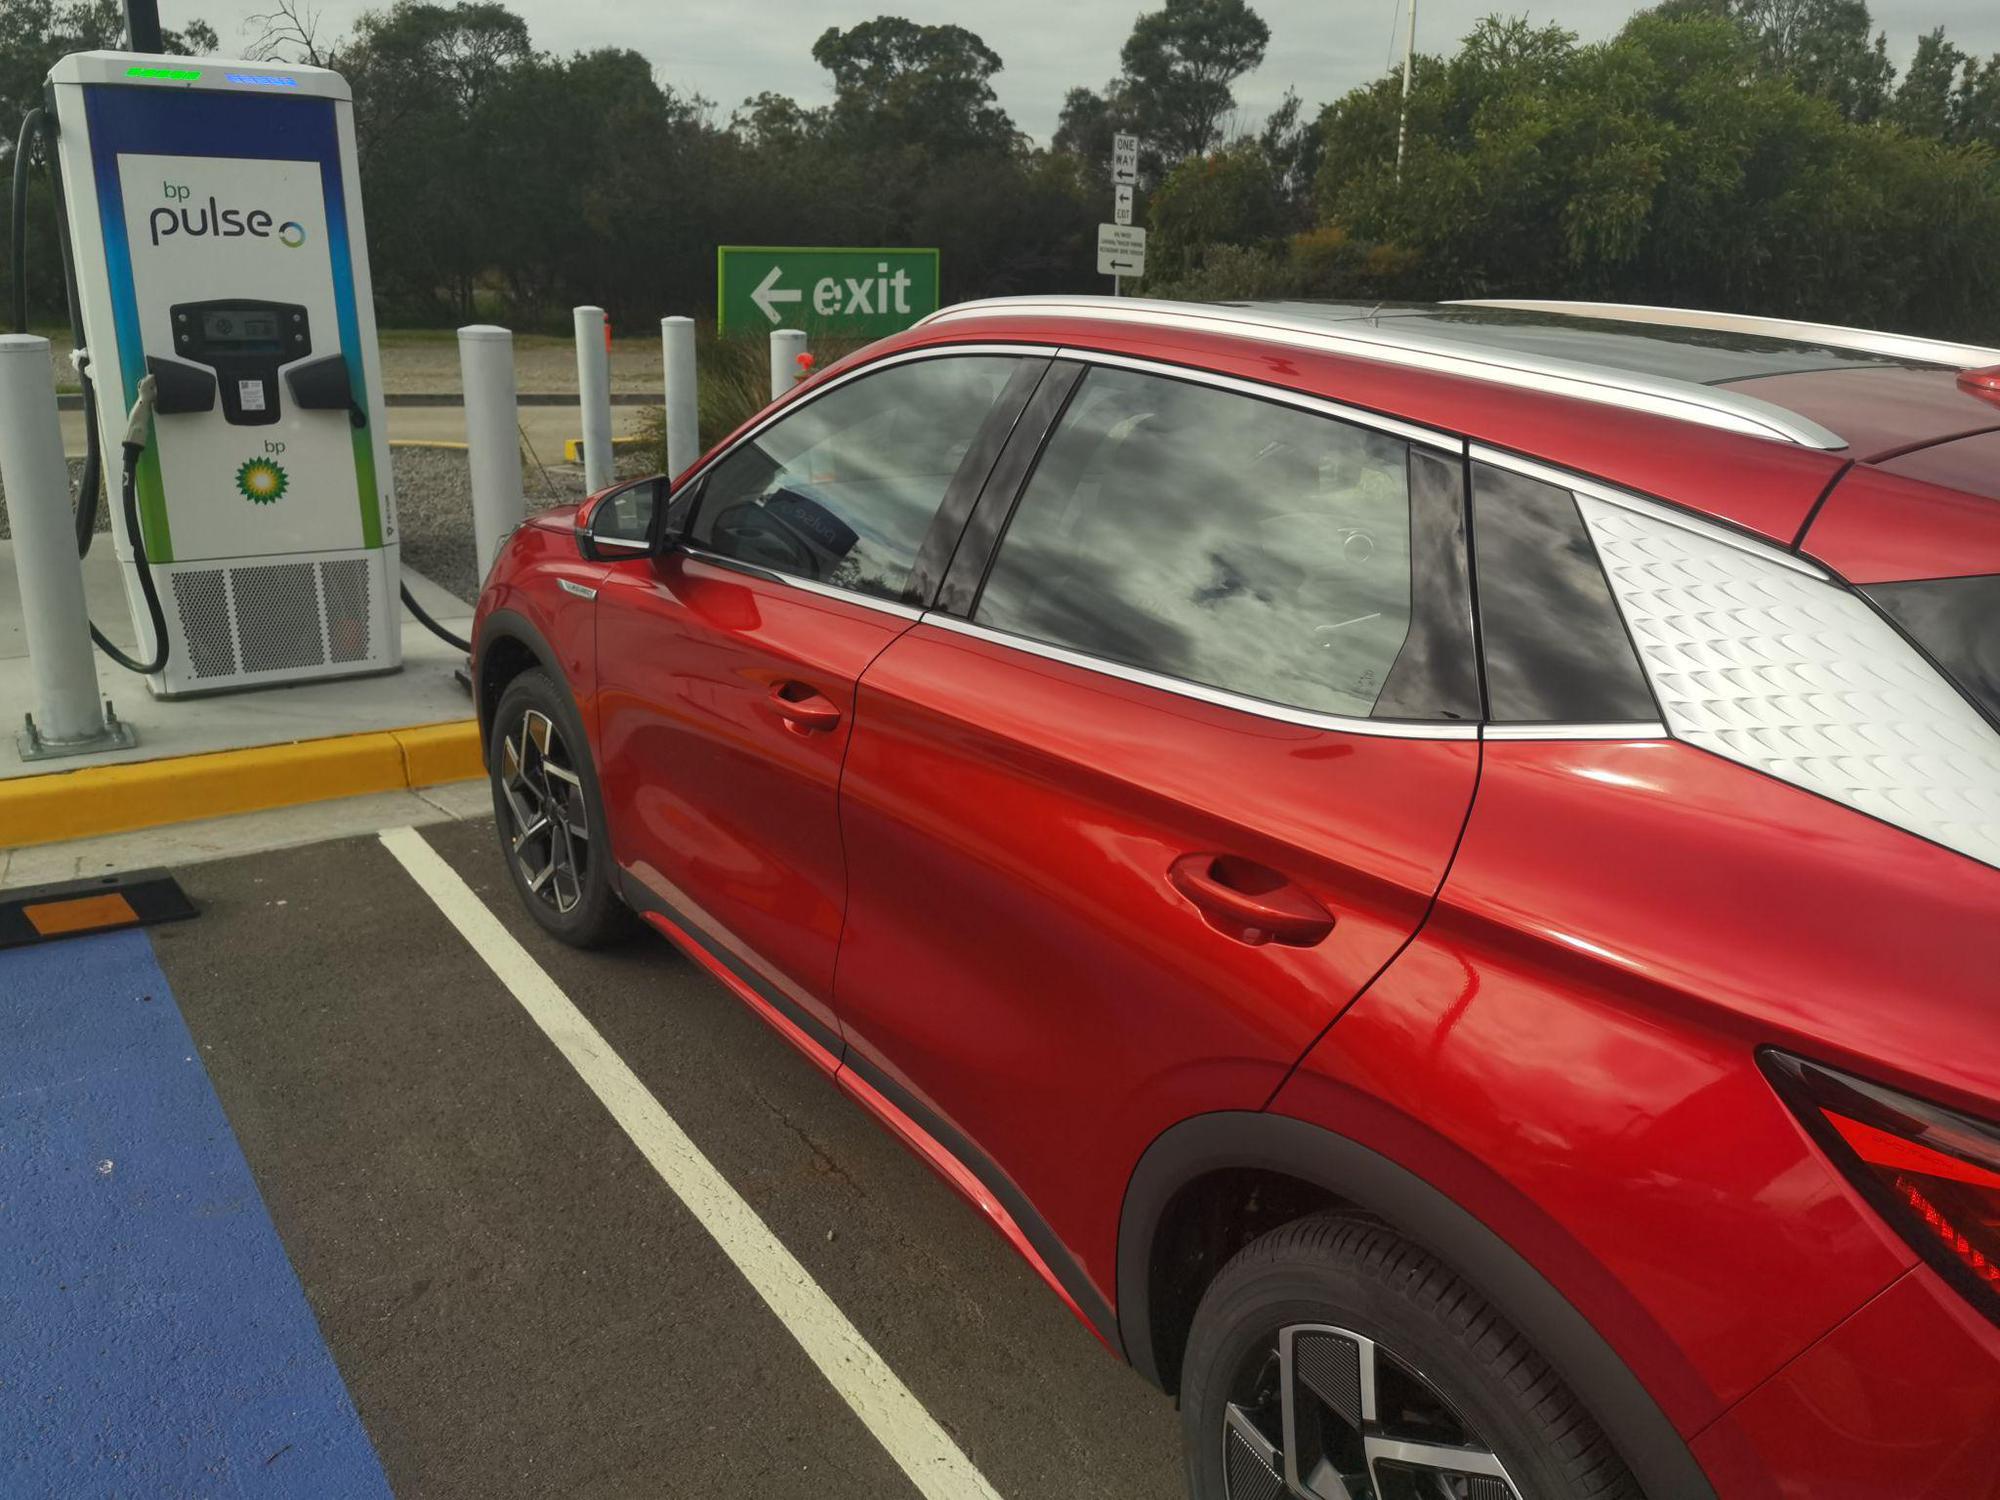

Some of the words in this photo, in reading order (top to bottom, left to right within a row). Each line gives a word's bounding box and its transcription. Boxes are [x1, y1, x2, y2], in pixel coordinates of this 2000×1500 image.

[1116, 139, 1136, 151] ONE
[1116, 155, 1136, 167] WAY
[163, 180, 190, 203] bp
[150, 196, 273, 246] pulse
[812, 262, 911, 316] exit
[264, 439, 286, 456] bp
